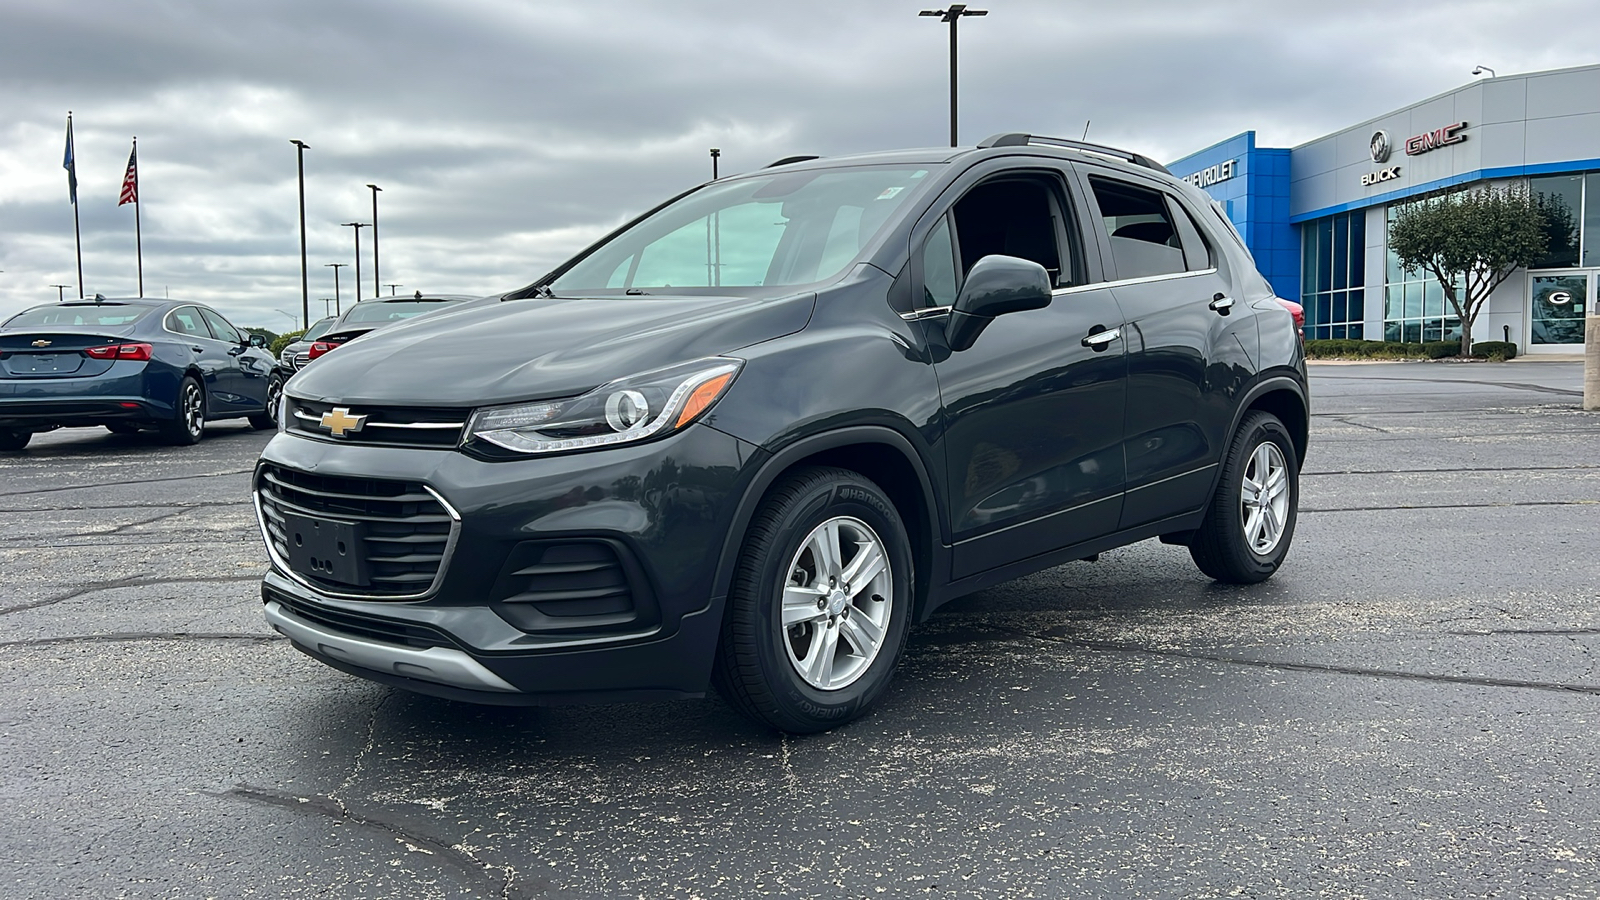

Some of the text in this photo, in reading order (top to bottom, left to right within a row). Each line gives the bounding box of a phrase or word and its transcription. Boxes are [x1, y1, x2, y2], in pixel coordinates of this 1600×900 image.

[1405, 123, 1463, 155] GMC
[1361, 166, 1398, 186] BUICK
[1549, 292, 1571, 304] G
